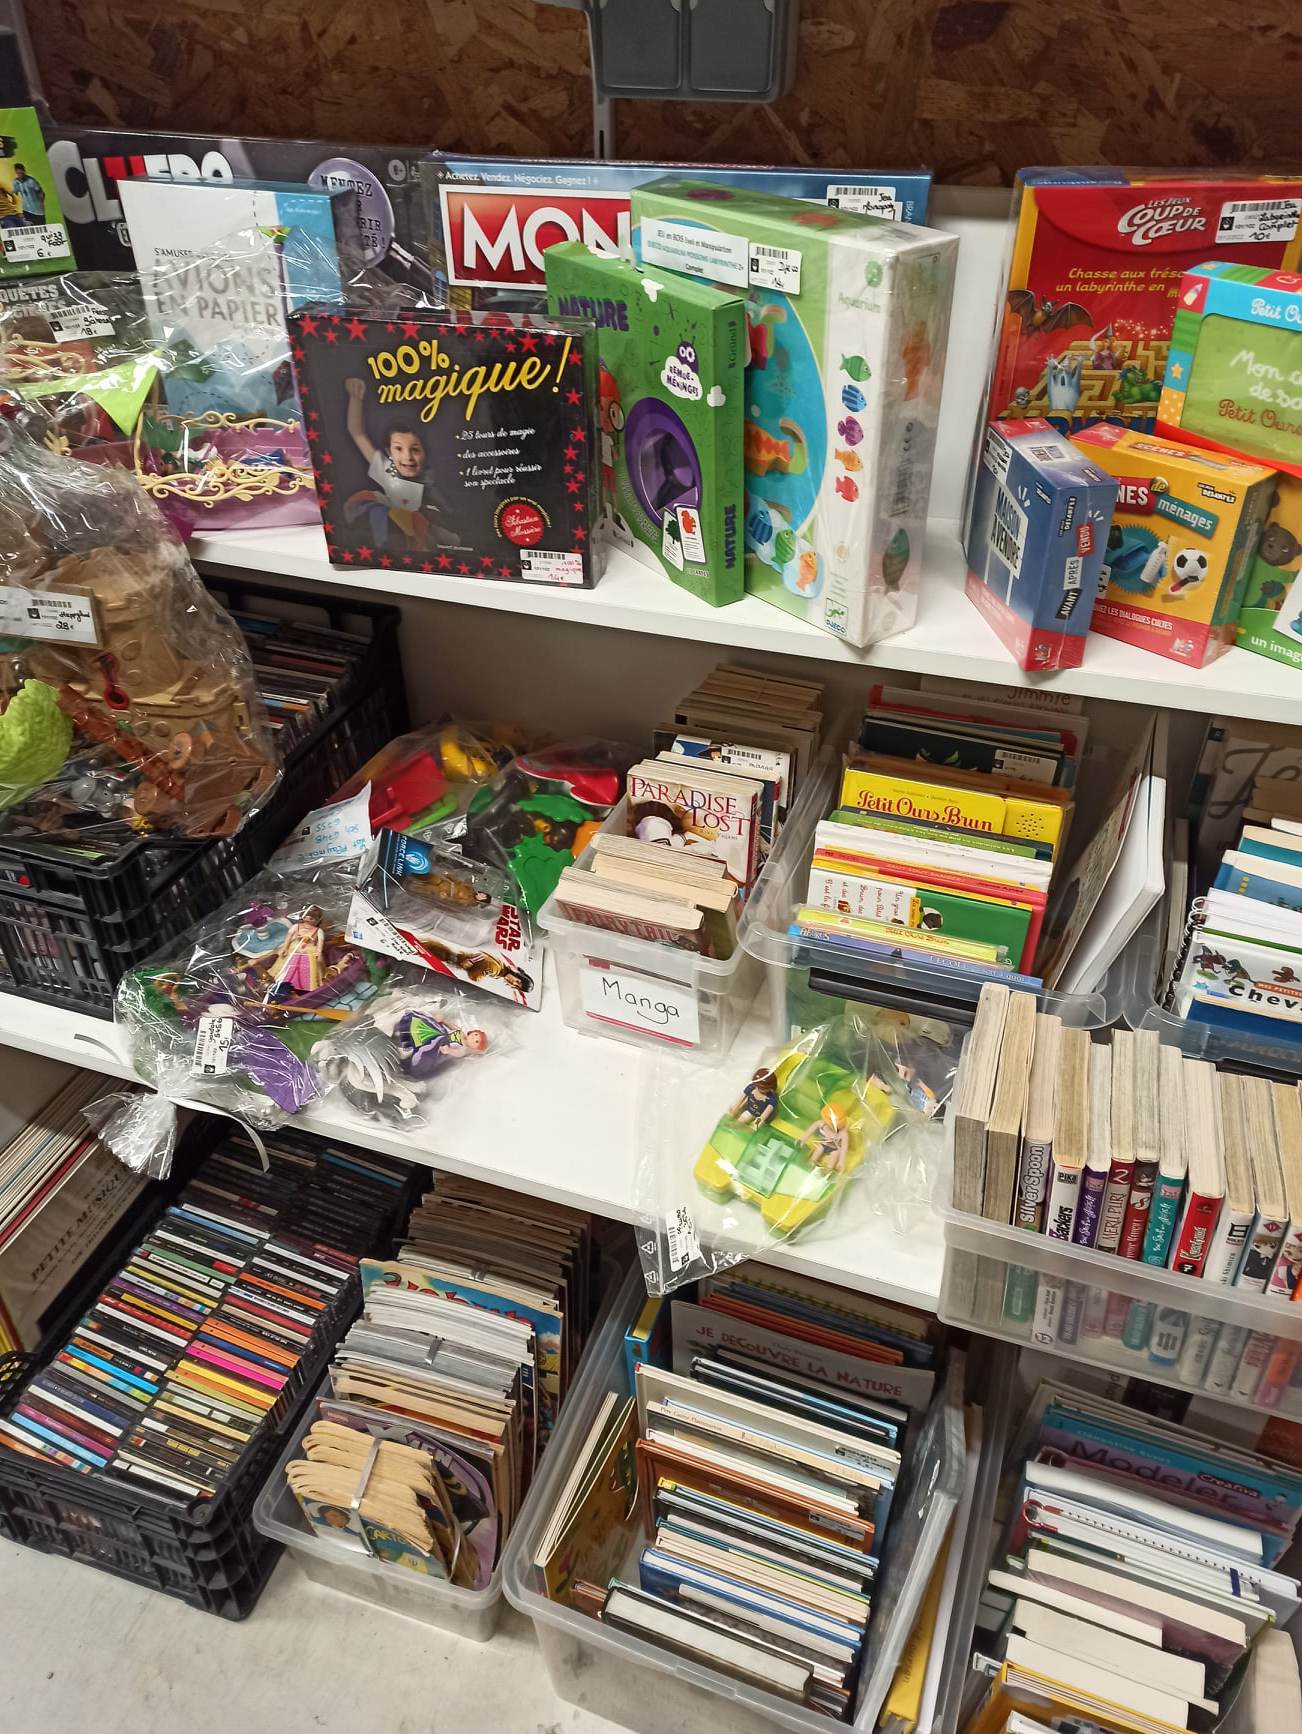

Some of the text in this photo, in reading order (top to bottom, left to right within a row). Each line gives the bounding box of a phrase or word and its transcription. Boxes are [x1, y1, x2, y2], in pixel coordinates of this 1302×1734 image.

[1118, 205, 1201, 233] COUP DE
[1055, 281, 1165, 293] un labyrinthe en
[1068, 268, 1117, 279] Chasse
[1120, 270, 1145, 279] aux
[199, 299, 280, 326] PAPIER
[1251, 298, 1282, 319] Petit
[367, 340, 450, 380] 100%
[1229, 350, 1284, 381] Mon
[378, 355, 551, 423] magique
[1250, 382, 1273, 402] de
[1218, 399, 1255, 424] Petit
[1158, 498, 1213, 530] ménages
[724, 504, 736, 569] NATURE
[1079, 524, 1091, 553] VENDU
[1061, 587, 1080, 617] AVANT
[1108, 606, 1119, 616] LES
[1119, 609, 1151, 625] DIALOGUES
[1251, 637, 1267, 648] un
[631, 776, 737, 816] PARADISE
[858, 790, 892, 813] Petit
[896, 797, 940, 821] Ours
[942, 805, 992, 832] Brun
[691, 806, 750, 836] LOST
[495, 904, 511, 950] WARS
[508, 905, 522, 952] STAR
[602, 976, 680, 1024] Manga
[1020, 1145, 1044, 1223] Silver Spoon
[1113, 1169, 1129, 1184] 2
[696, 1326, 714, 1339] JE
[808, 1360, 828, 1378] LA
[837, 1371, 903, 1398] NATURE
[1070, 1441, 1238, 1504] Modeler
